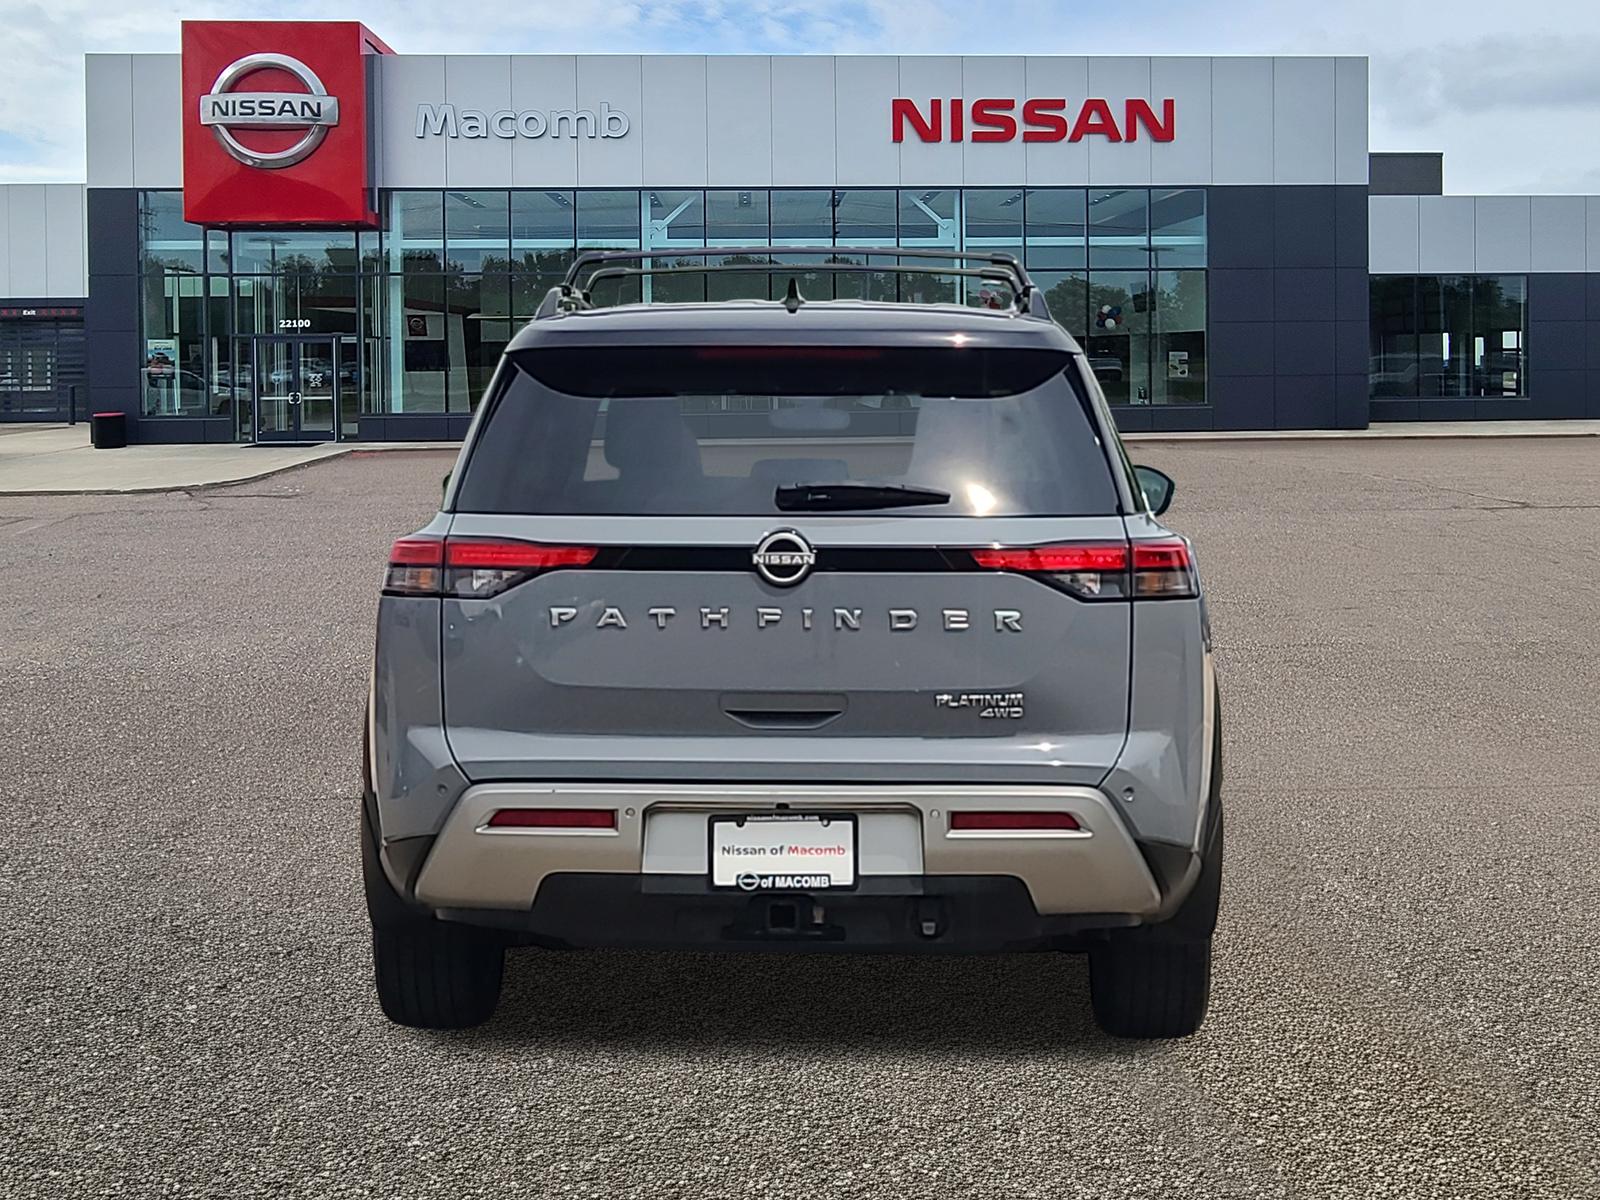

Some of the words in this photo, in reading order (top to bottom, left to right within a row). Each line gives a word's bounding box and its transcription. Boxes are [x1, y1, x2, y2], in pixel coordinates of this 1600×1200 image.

[211, 100, 322, 117] NISSAN
[415, 102, 630, 138] Macomb
[892, 98, 1175, 143] NISSAN
[279, 319, 311, 328] 22100
[752, 553, 816, 565] NISSAN
[549, 607, 1023, 632] PATHFINDER
[935, 693, 1024, 707] PLATINUM
[979, 707, 1024, 718] 4WD
[721, 845, 767, 856] Nissan
[770, 845, 785, 856] of
[787, 845, 846, 856] Macomb
[760, 876, 774, 888] of
[775, 875, 830, 888] MACOMB
